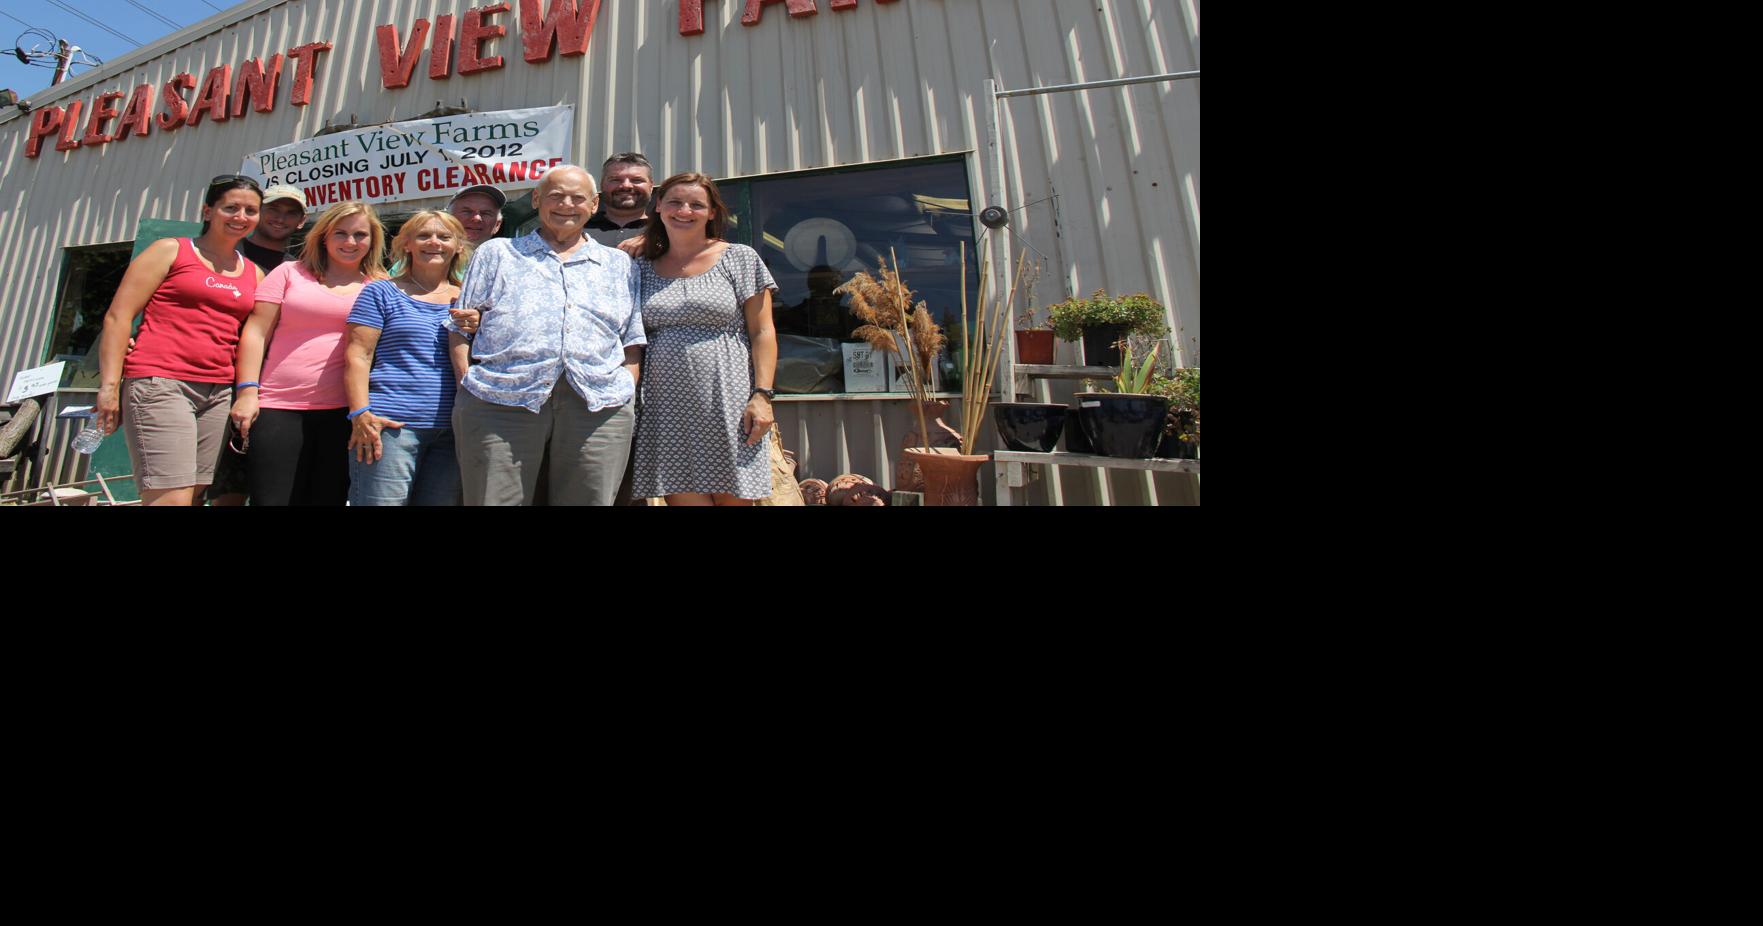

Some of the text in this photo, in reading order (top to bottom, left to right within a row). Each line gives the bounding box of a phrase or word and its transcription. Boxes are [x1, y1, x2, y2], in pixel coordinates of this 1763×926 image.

[24, 0, 601, 158] PLEASANT VIEW
[259, 120, 540, 175] Pleasant View Farms
[265, 175, 279, 189] IS
[285, 159, 369, 185] CLOSING
[380, 149, 429, 170] JULY
[461, 142, 523, 160] 2012
[303, 172, 407, 208] NVENTORY
